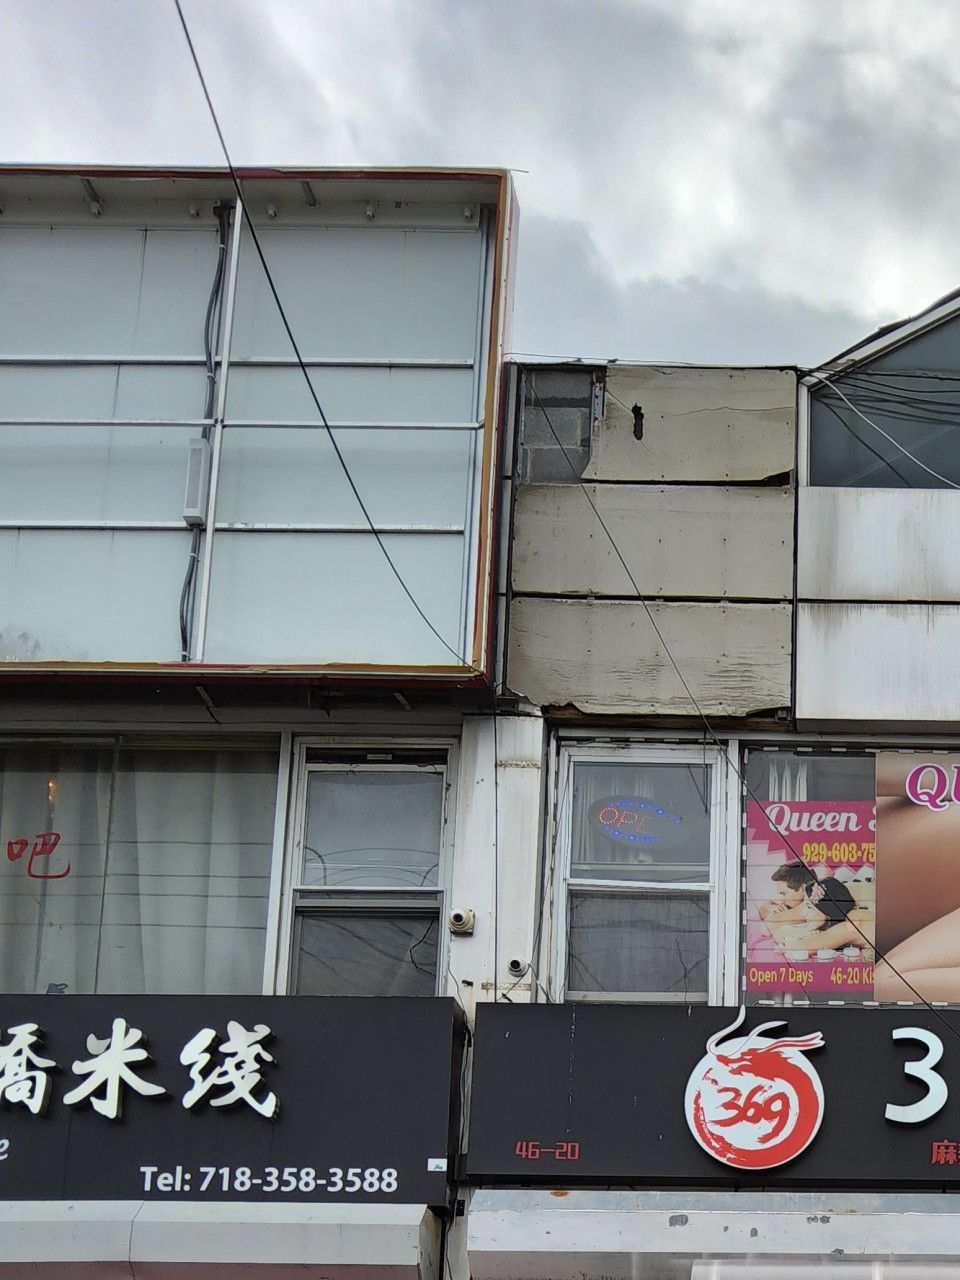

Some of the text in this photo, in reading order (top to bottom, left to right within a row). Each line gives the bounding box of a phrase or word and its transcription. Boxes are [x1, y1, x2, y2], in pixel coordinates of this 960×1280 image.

[765, 803, 862, 836] Queen
[7, 831, 71, 880] 吧
[750, 967, 778, 986] Open
[780, 968, 785, 982] 7
[789, 968, 813, 984] Days
[831, 968, 860, 984] 46-20
[709, 1085, 790, 1144] 369
[515, 1140, 580, 1160] 46-20
[140, 1165, 398, 1192] Tel: 718-358-3588
